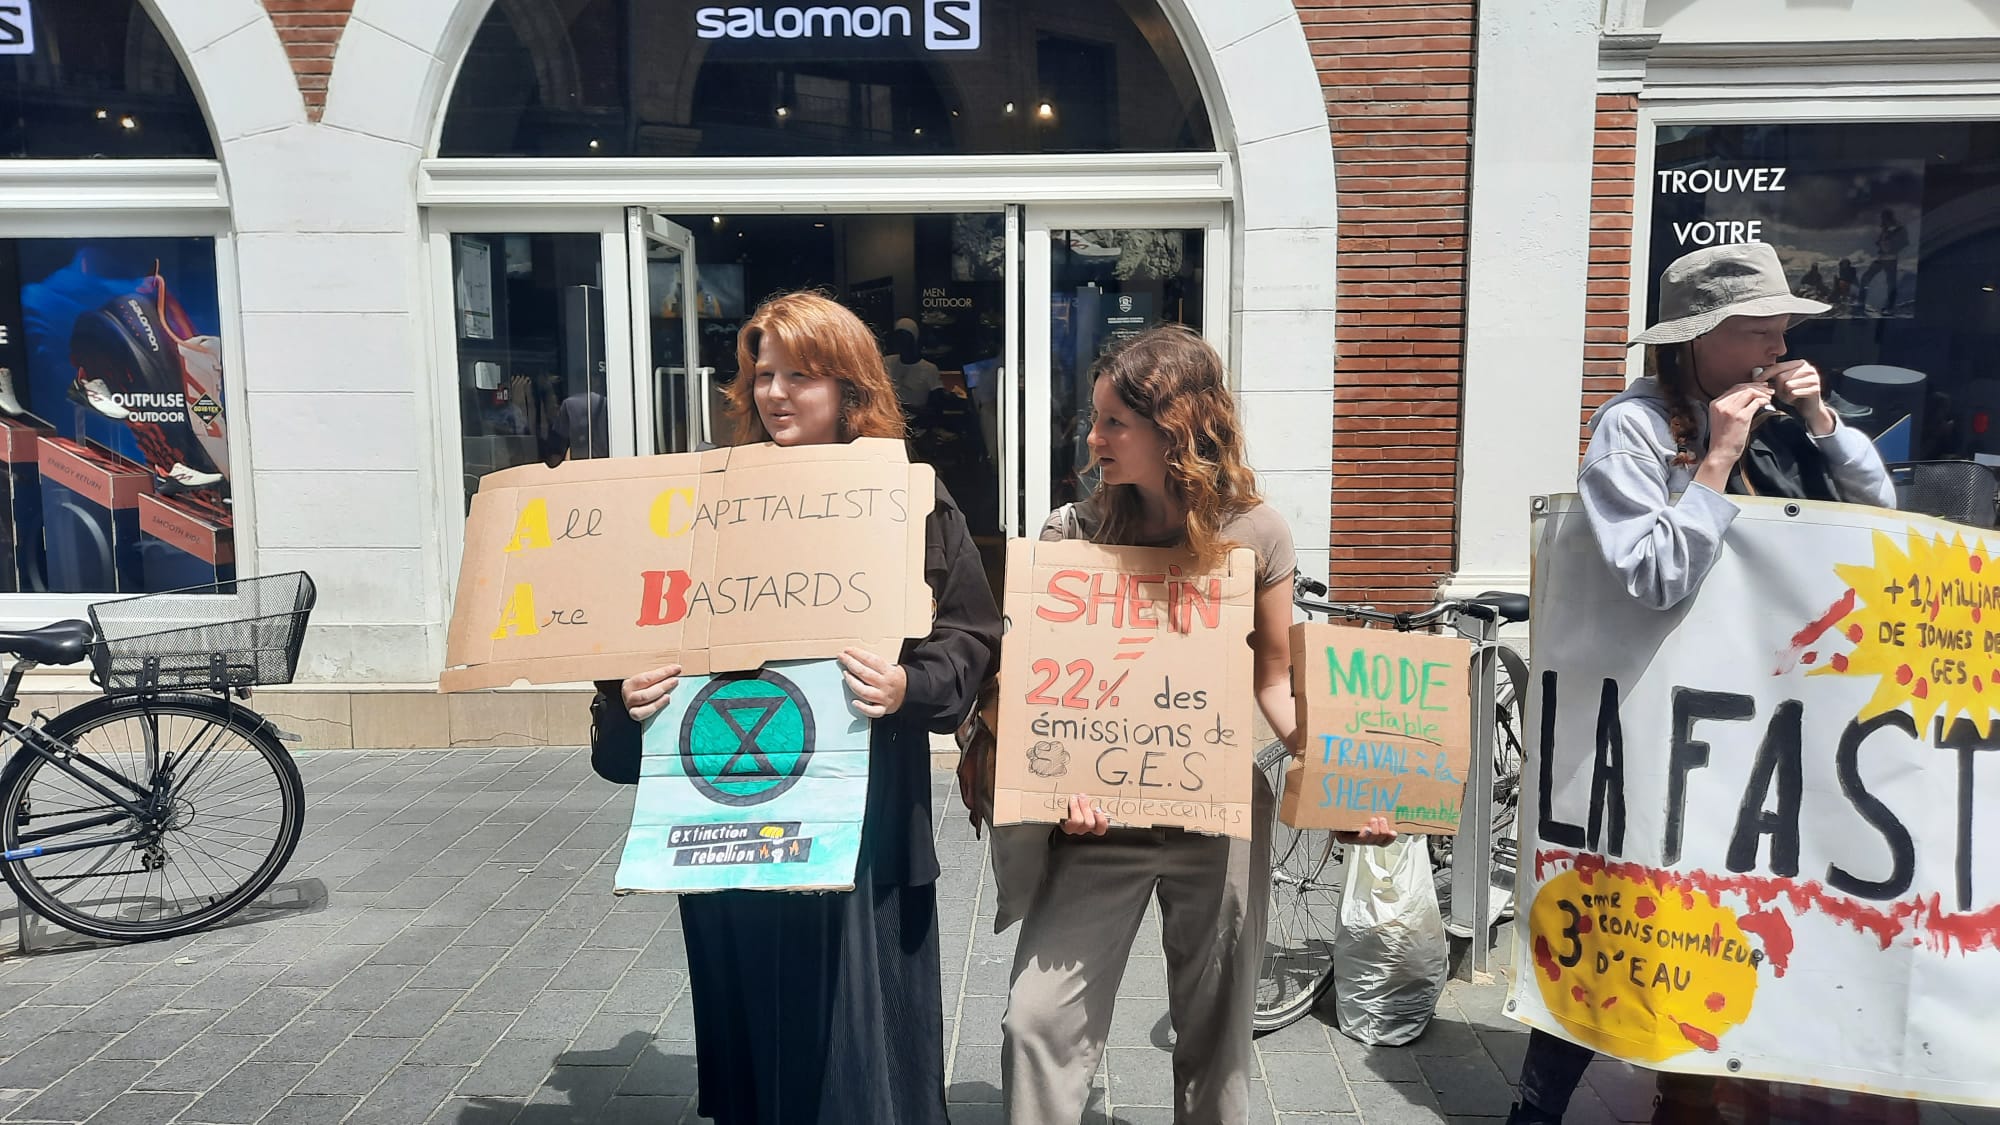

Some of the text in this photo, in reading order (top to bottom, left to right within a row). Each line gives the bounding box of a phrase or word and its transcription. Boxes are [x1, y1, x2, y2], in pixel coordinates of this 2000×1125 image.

[1658, 168, 1786, 193] TROUVEZ
[1673, 221, 1762, 245] VOTRE
[923, 288, 945, 297] MEN
[923, 298, 972, 307] OUTDOOR
[112, 393, 185, 408] OUTPULSE
[129, 411, 185, 423] OUTDOOR
[503, 487, 908, 552] All CAPITALISTS
[490, 570, 872, 640] Are BASTARDS
[1879, 621, 1905, 647] DE
[1916, 622, 1973, 651] TONNES
[1025, 658, 1207, 710] 22% des
[1325, 645, 1452, 711] MODE
[1931, 657, 1967, 685] GES
[1031, 712, 1238, 747] émissions de
[1345, 701, 1445, 742] jetable
[1096, 747, 1207, 791] G.E.S
[1318, 733, 1461, 784] TRAVAIL à la
[1318, 772, 1403, 813] SHEIN
[1538, 670, 2000, 912] LA FAST
[1395, 797, 1460, 825] minable
[670, 825, 748, 844] extinction
[691, 845, 754, 865] rebellion
[1597, 951, 1691, 992] D'EAU
